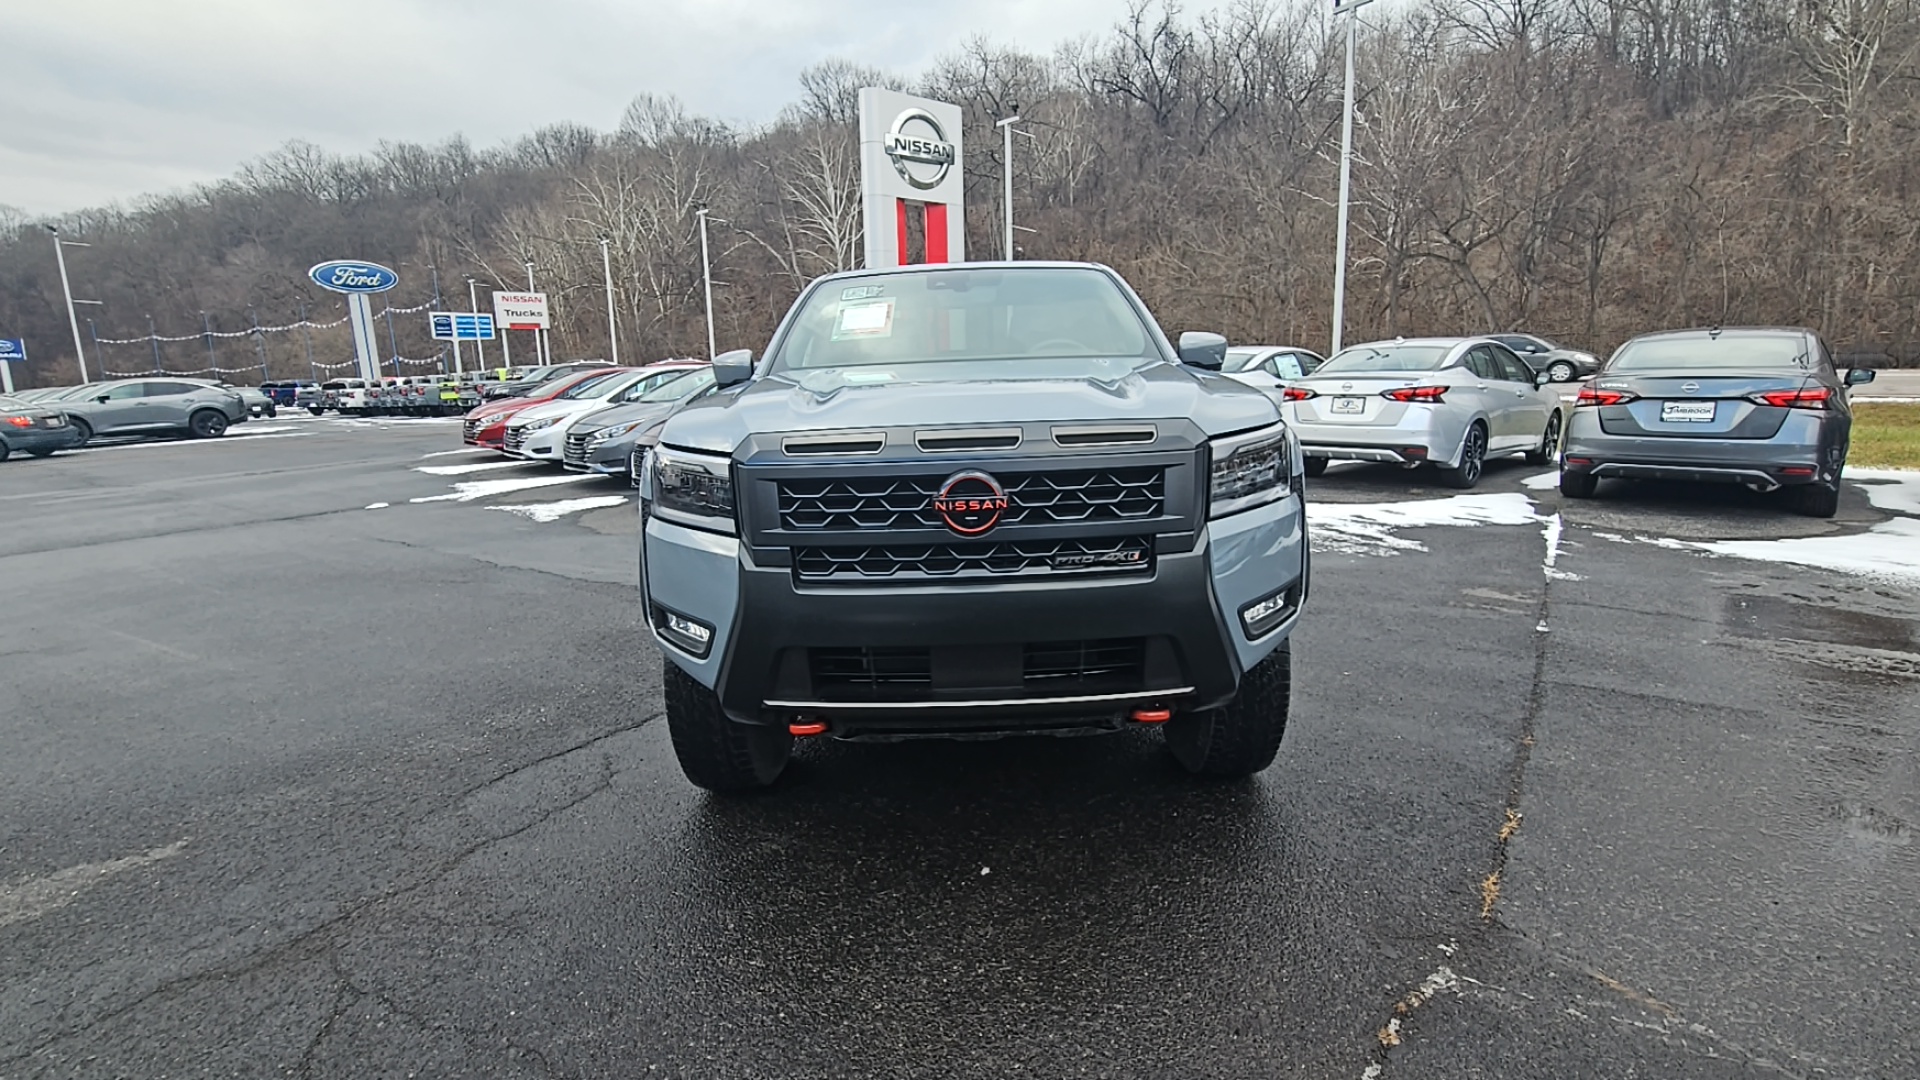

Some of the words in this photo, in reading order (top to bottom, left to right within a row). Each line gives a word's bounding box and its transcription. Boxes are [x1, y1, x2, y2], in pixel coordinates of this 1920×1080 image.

[894, 138, 951, 158] NISSAN
[331, 267, 381, 286] Ford
[504, 309, 543, 317] Trucks
[934, 499, 1008, 511] NISSAN
